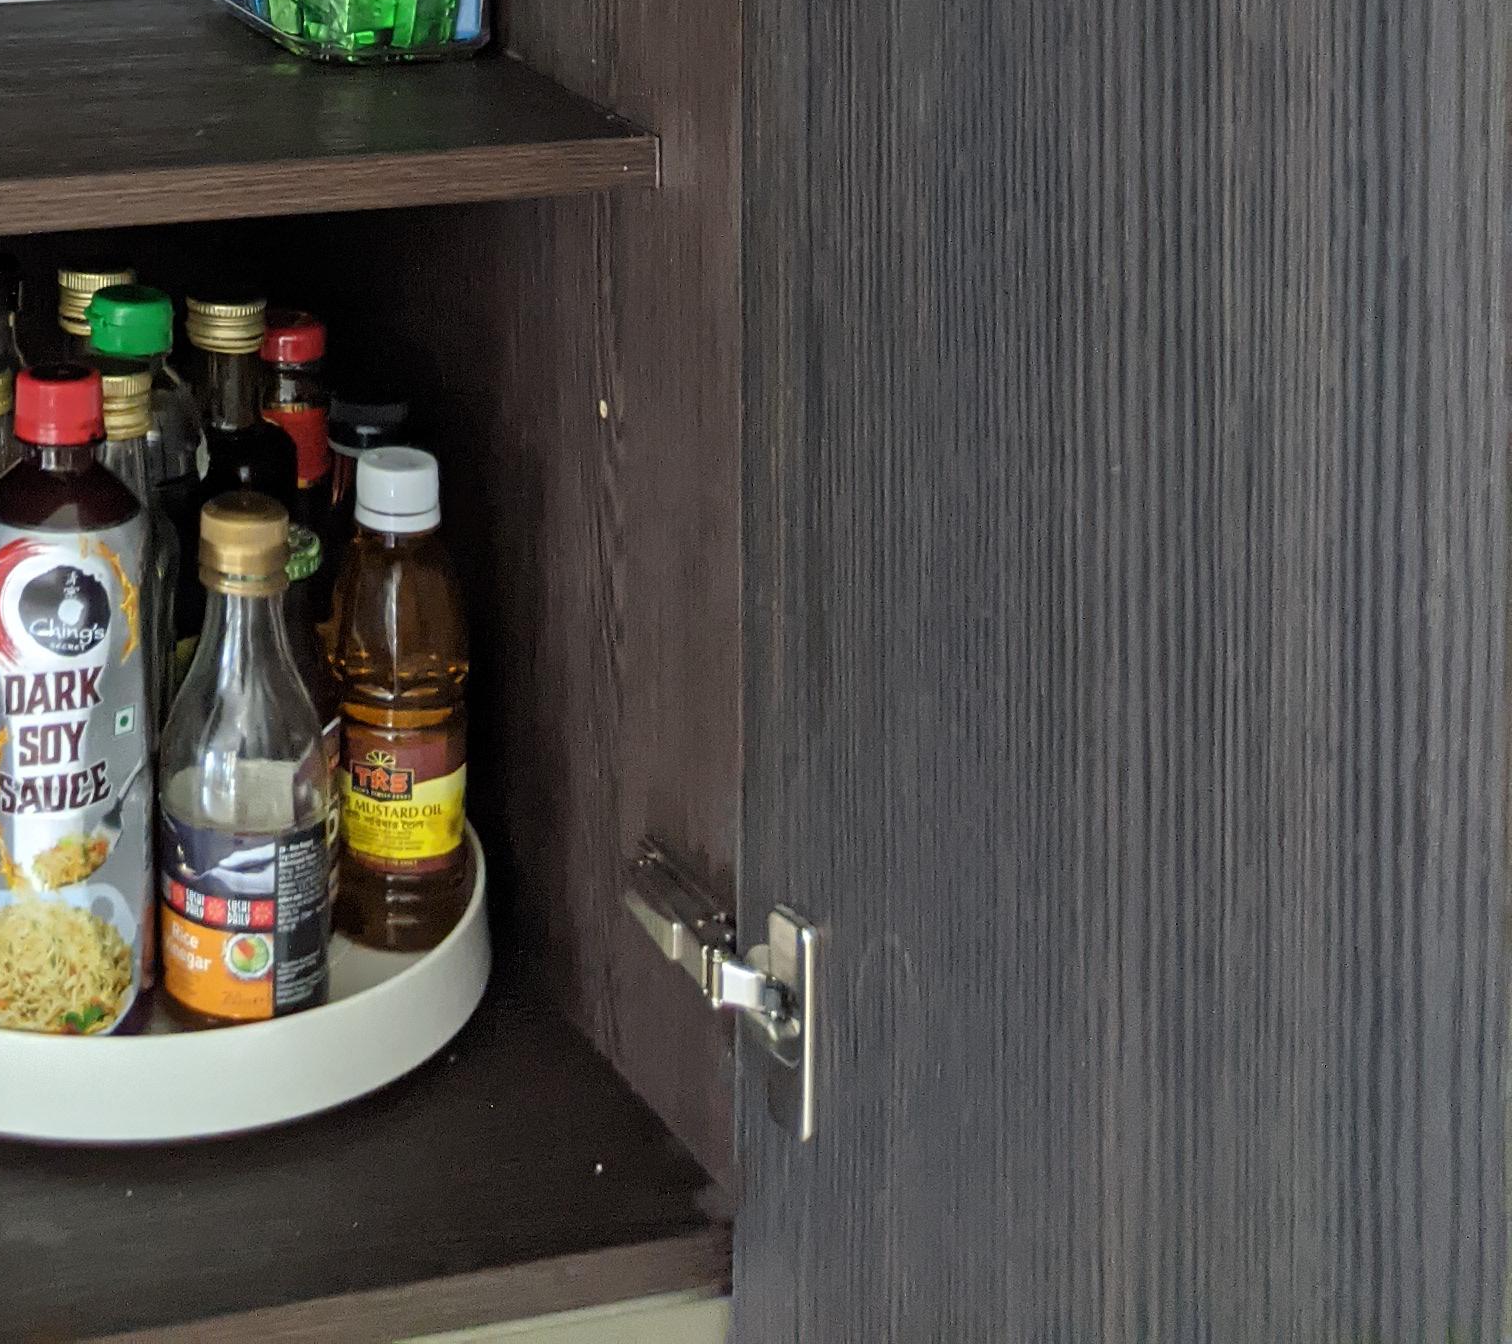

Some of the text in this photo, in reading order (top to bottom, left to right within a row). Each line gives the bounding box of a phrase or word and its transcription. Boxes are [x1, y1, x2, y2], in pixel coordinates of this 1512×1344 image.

[29, 617, 106, 644] Ching's
[4, 665, 104, 716] DARK
[18, 720, 88, 767] SOY
[354, 765, 409, 794] TRS
[354, 799, 443, 819] MUSTARD OIL
[226, 898, 251, 912] SUSHI
[226, 911, 251, 926] DAILY
[171, 920, 200, 949] Rice
